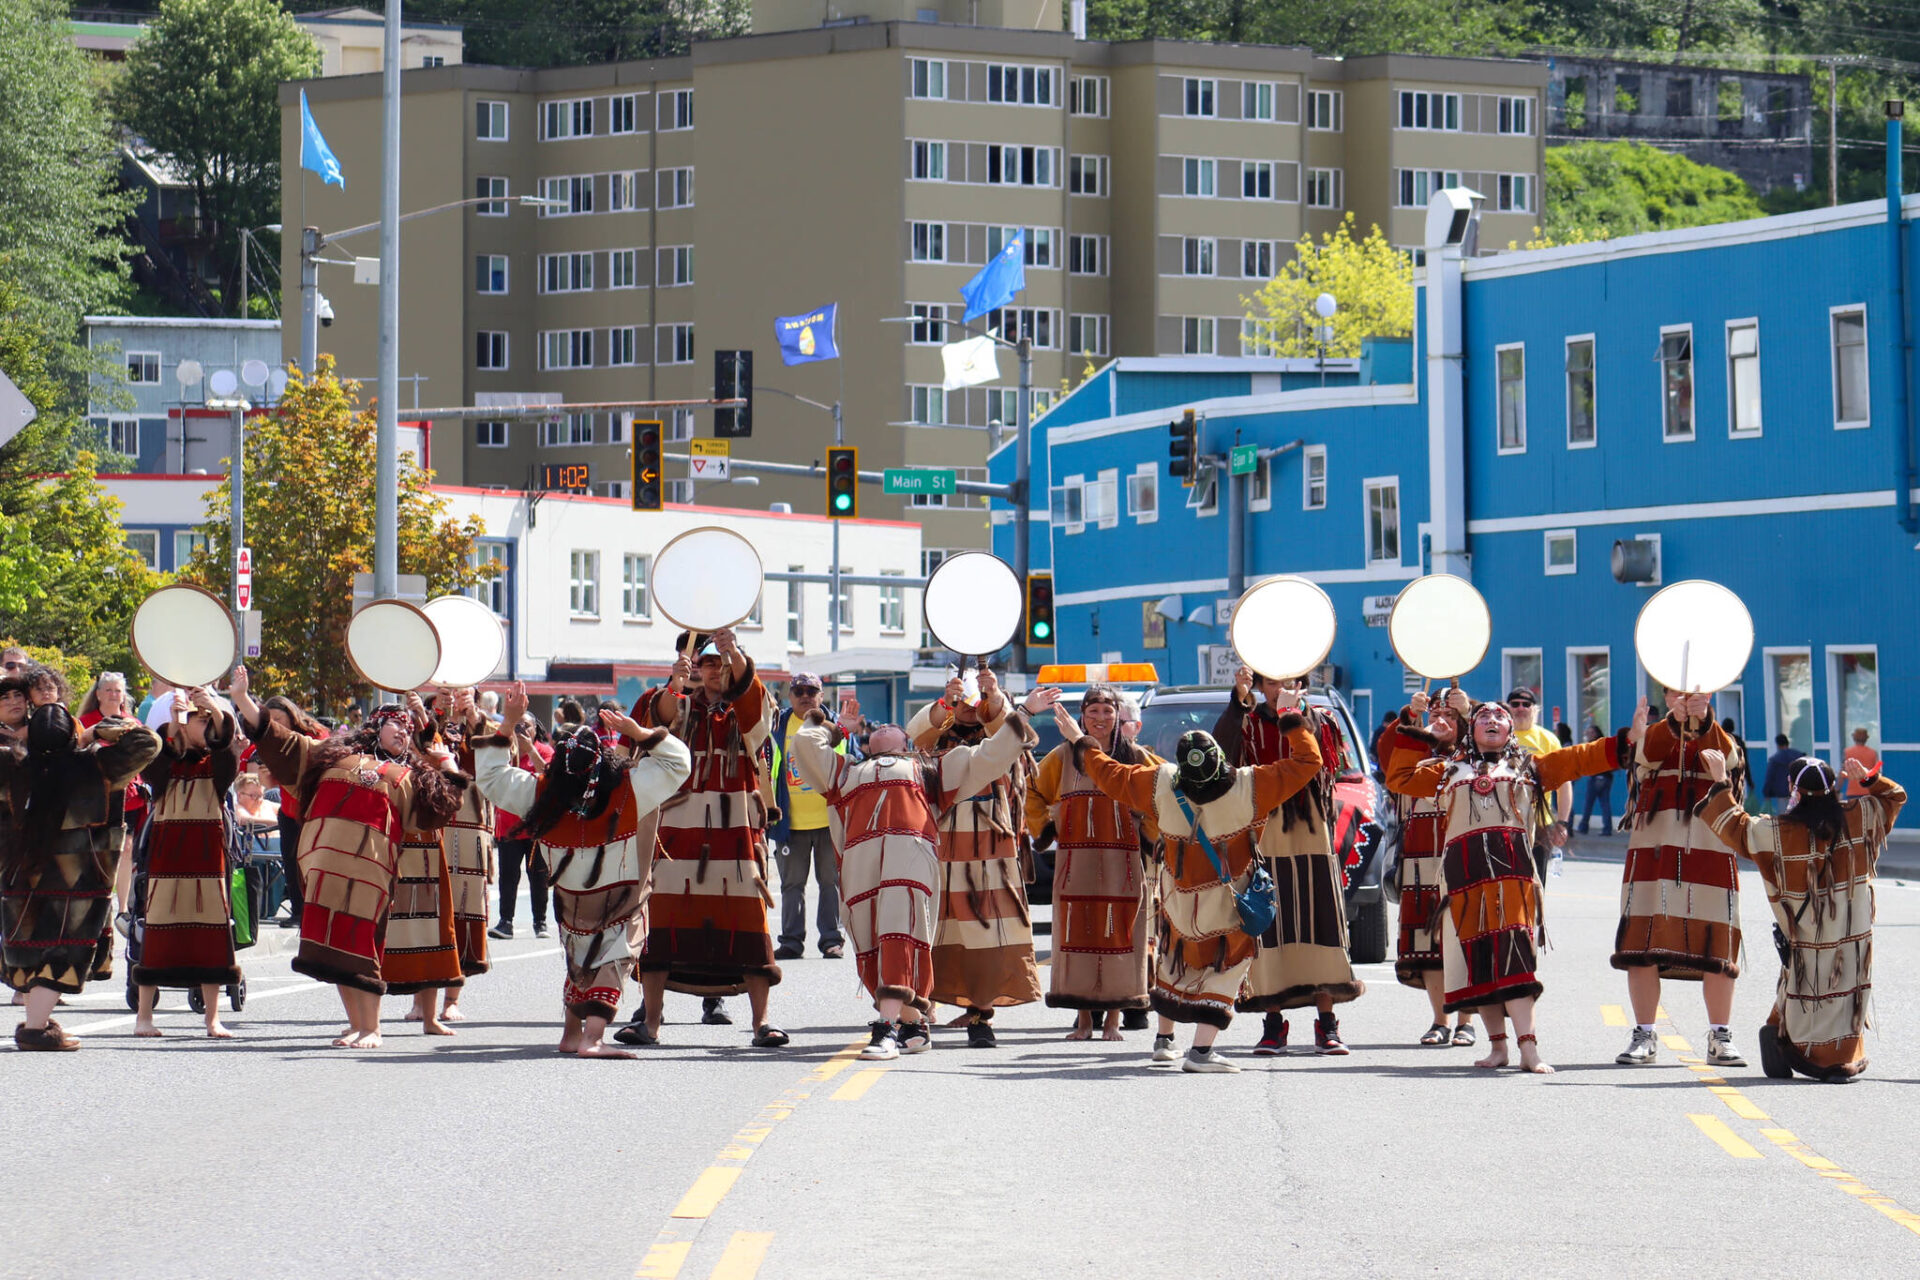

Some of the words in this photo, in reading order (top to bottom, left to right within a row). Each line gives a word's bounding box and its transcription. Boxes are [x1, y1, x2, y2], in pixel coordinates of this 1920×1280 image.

[546, 466, 588, 489] 11:02
[892, 475, 922, 488] Main
[932, 475, 946, 488] St
[249, 646, 258, 655] 19
[1216, 668, 1230, 676] MAY
